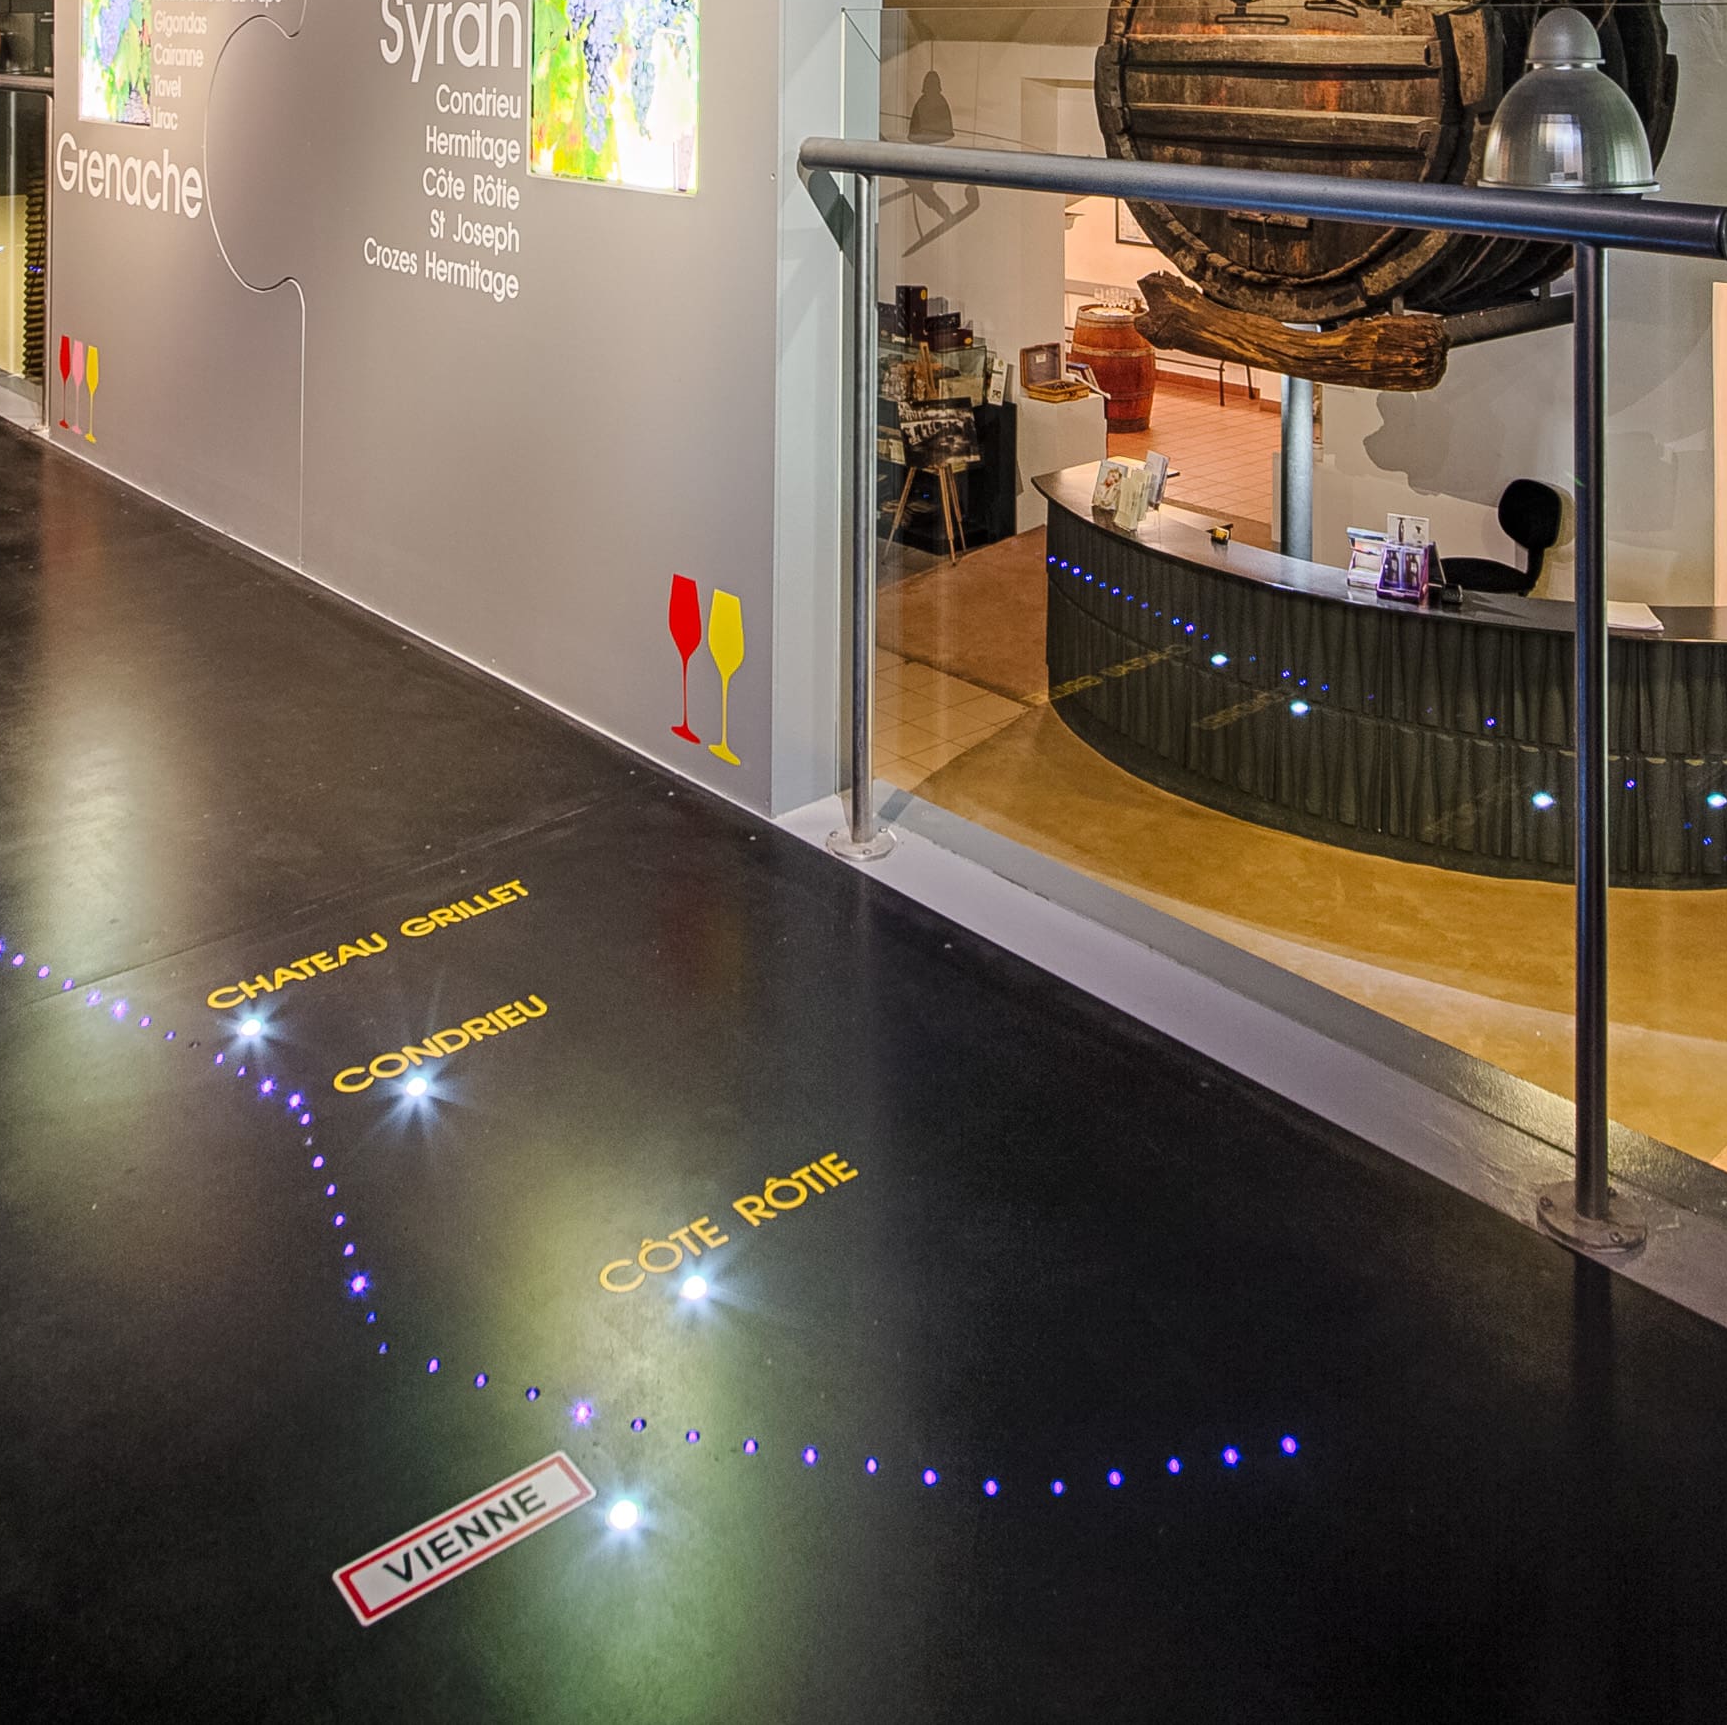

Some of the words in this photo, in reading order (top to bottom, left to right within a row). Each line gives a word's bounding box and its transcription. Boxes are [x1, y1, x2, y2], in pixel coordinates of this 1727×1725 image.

[153, 12, 207, 38] Gigondas
[153, 45, 204, 68] Cairanne
[153, 75, 182, 98] Tavel
[435, 83, 522, 119] Condrieu
[152, 106, 178, 131] Lirac
[426, 125, 521, 169] Hermitage
[56, 132, 203, 219] Grenache
[422, 167, 465, 201] Côte
[473, 177, 520, 210] Rôtie
[430, 209, 446, 238] St
[453, 214, 520, 256] Joseph
[364, 237, 418, 274] Crozes
[425, 251, 519, 303] Hermitage
[206, 932, 388, 1010] CHATEAU
[400, 879, 530, 939] GRILLET
[332, 993, 549, 1094] CONDRIEU
[599, 1216, 730, 1294] CÔTE
[732, 1152, 859, 1227] RÔTIE
[383, 1485, 547, 1583] VIENNE
